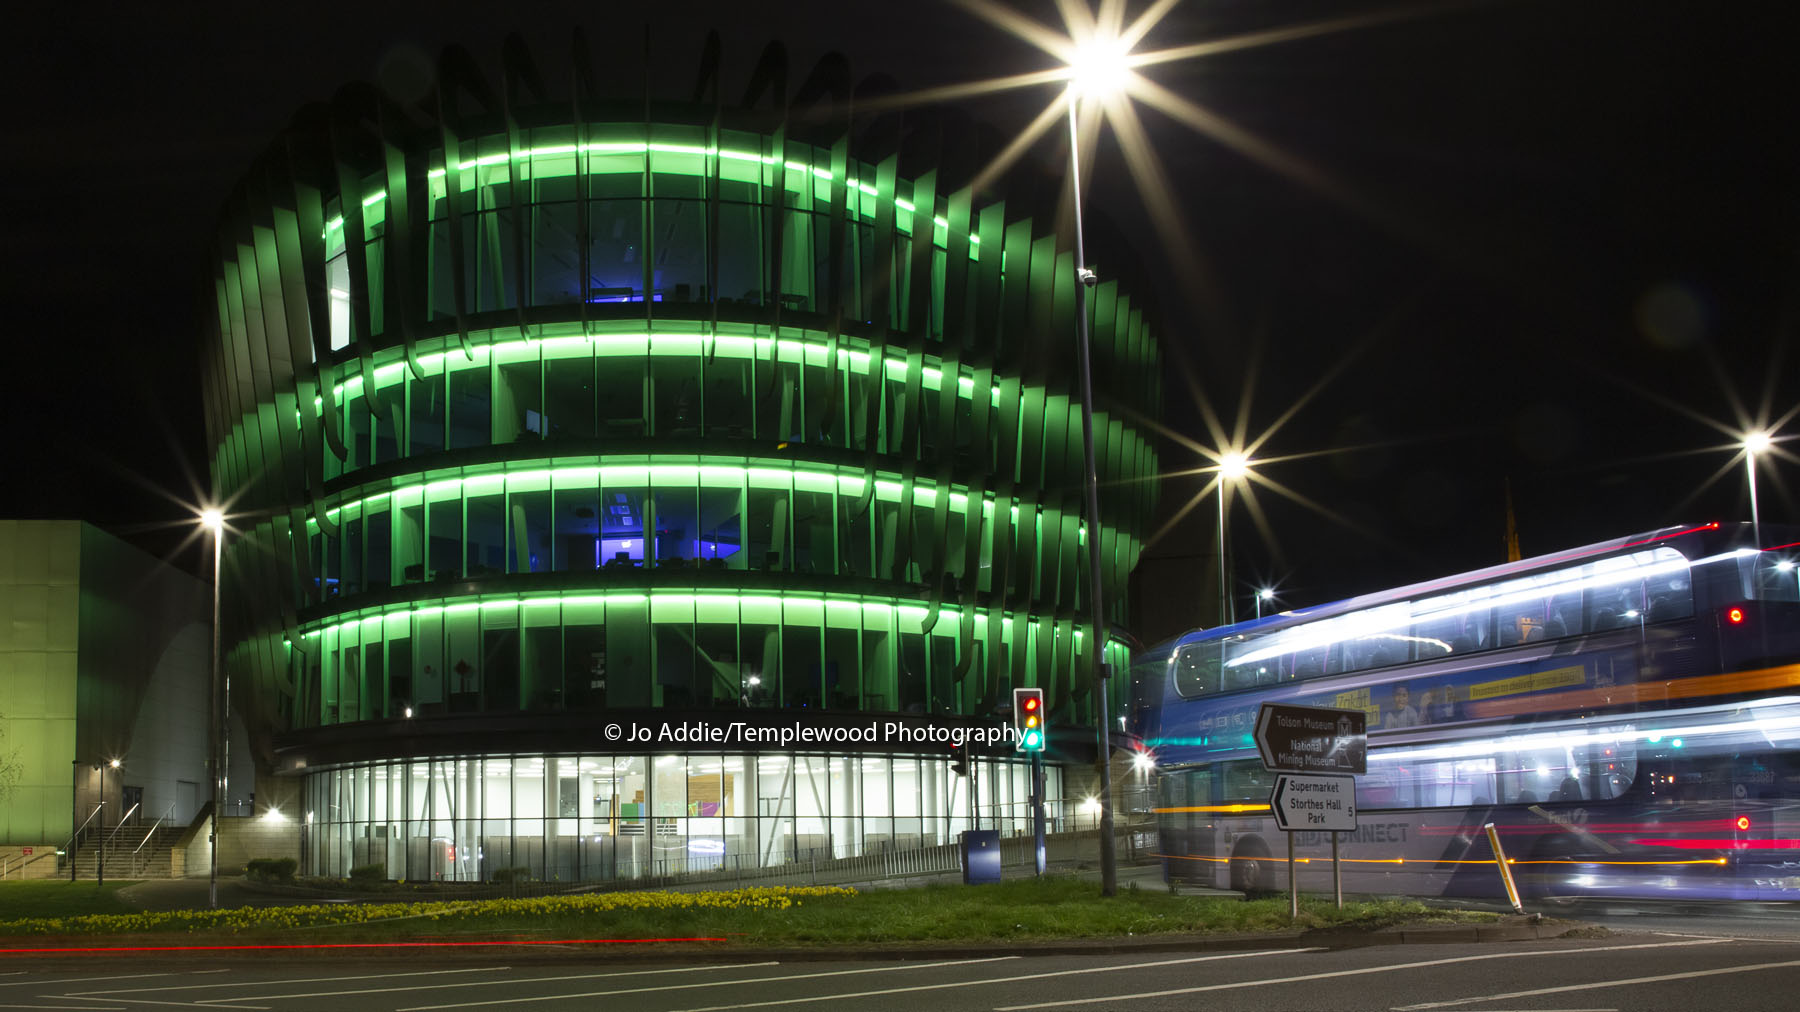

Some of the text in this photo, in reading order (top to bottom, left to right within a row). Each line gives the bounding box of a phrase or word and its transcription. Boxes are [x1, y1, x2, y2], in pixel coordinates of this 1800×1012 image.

[1276, 715, 1334, 730] Tolson Museum
[1291, 739, 1322, 753] National
[1278, 753, 1336, 767] Mining Museum
[1290, 780, 1340, 793] Supermarket
[1291, 798, 1341, 810] Storthes Hall
[1308, 812, 1326, 824] Park
[1348, 806, 1353, 817] 5
